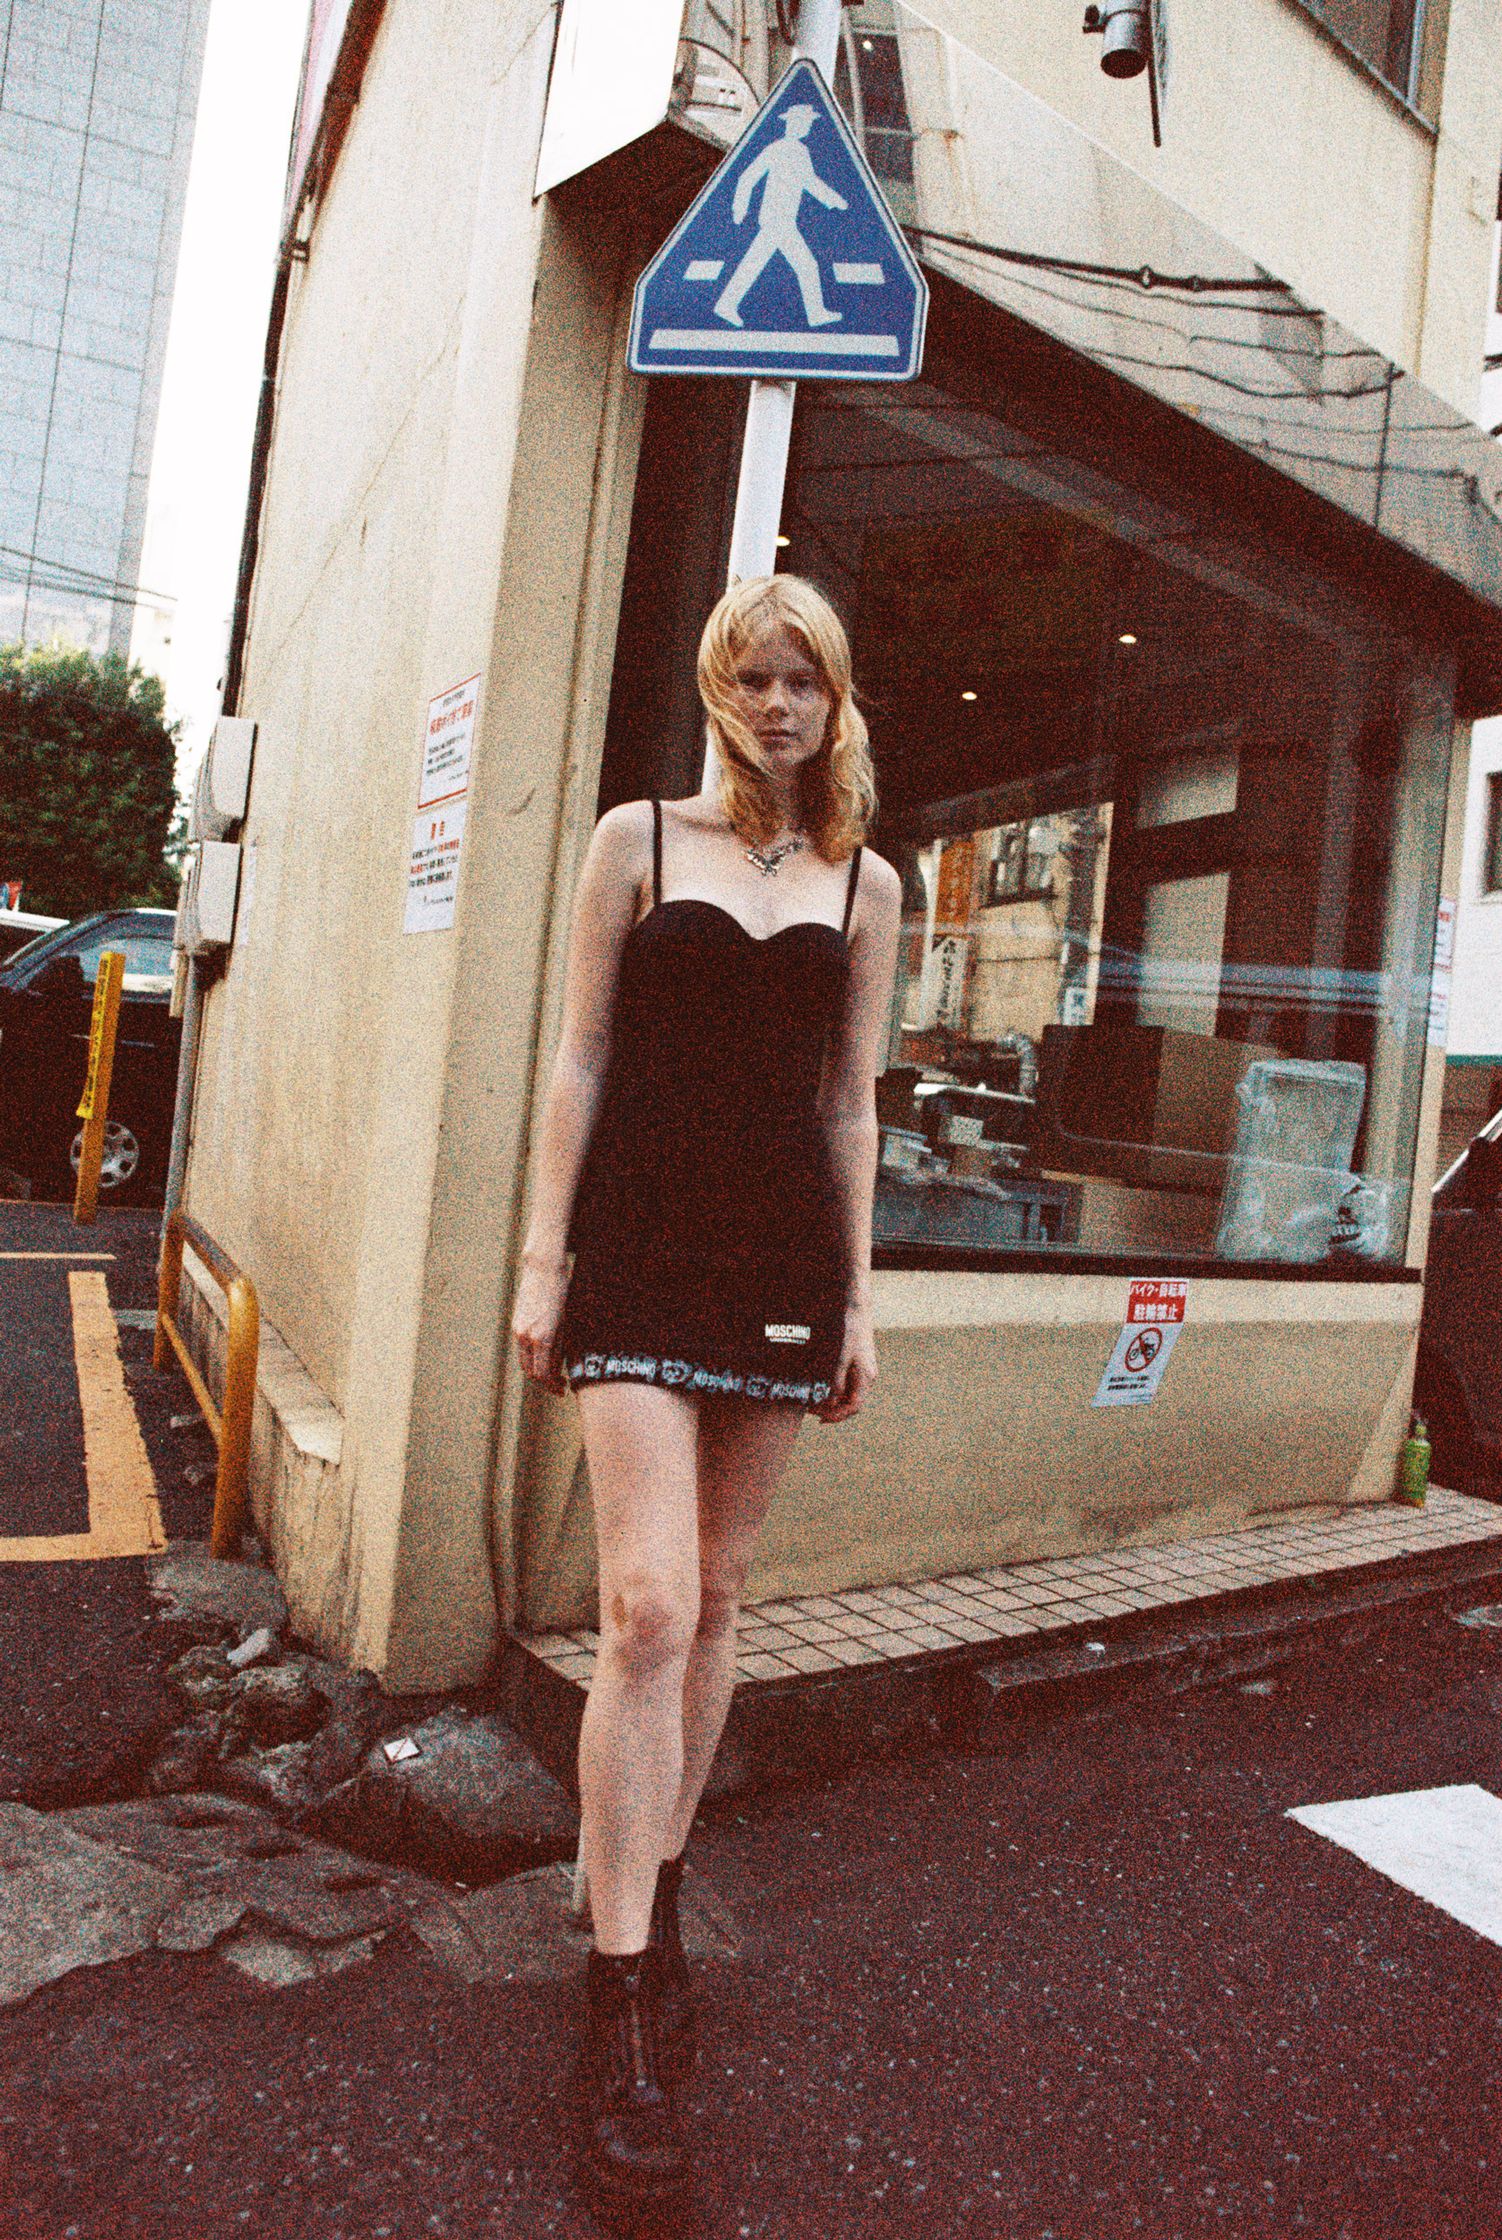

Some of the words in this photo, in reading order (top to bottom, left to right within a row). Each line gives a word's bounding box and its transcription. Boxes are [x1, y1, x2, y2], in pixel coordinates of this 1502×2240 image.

[1131, 1283, 1187, 1297] バイク・自転車
[1134, 1304, 1178, 1320] 駐輪禁止
[765, 1324, 811, 1339] MOSCHINO
[606, 1358, 656, 1376] MOSCHINO
